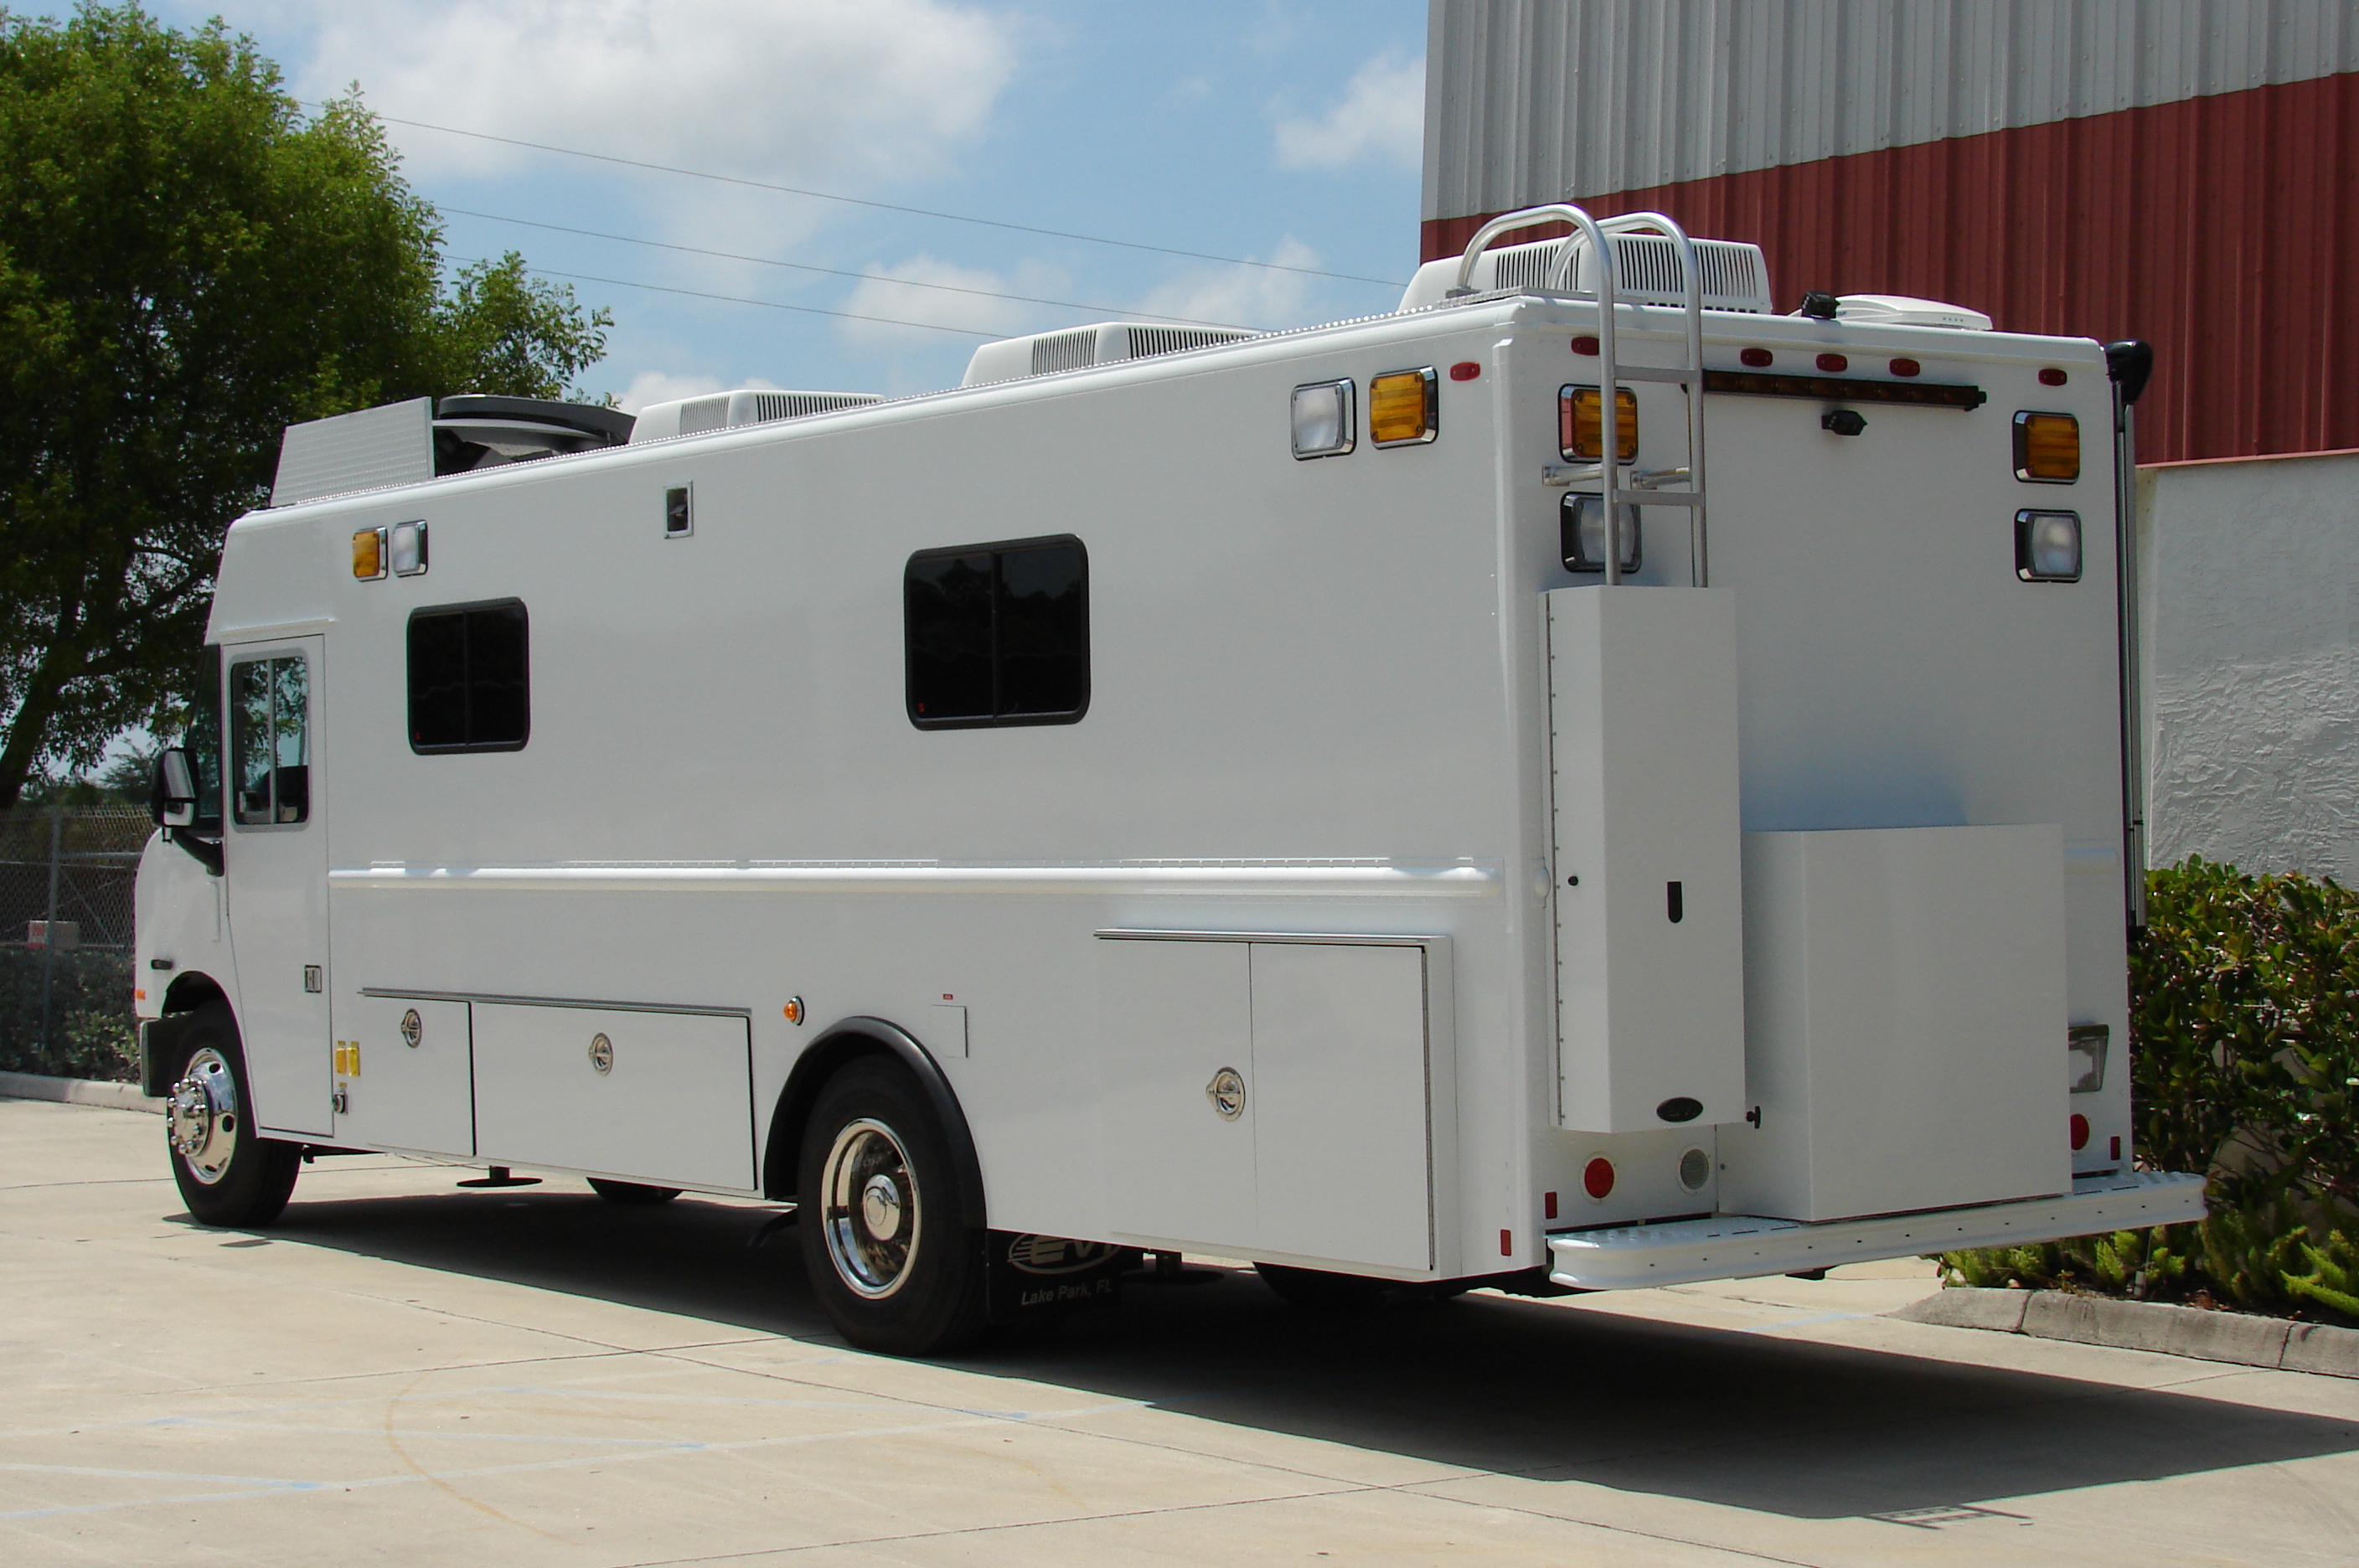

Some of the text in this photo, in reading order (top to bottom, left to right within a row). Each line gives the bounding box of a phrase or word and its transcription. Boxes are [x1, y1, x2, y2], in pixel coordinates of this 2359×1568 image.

[1021, 1278, 1113, 1306] Lake Park, FL
